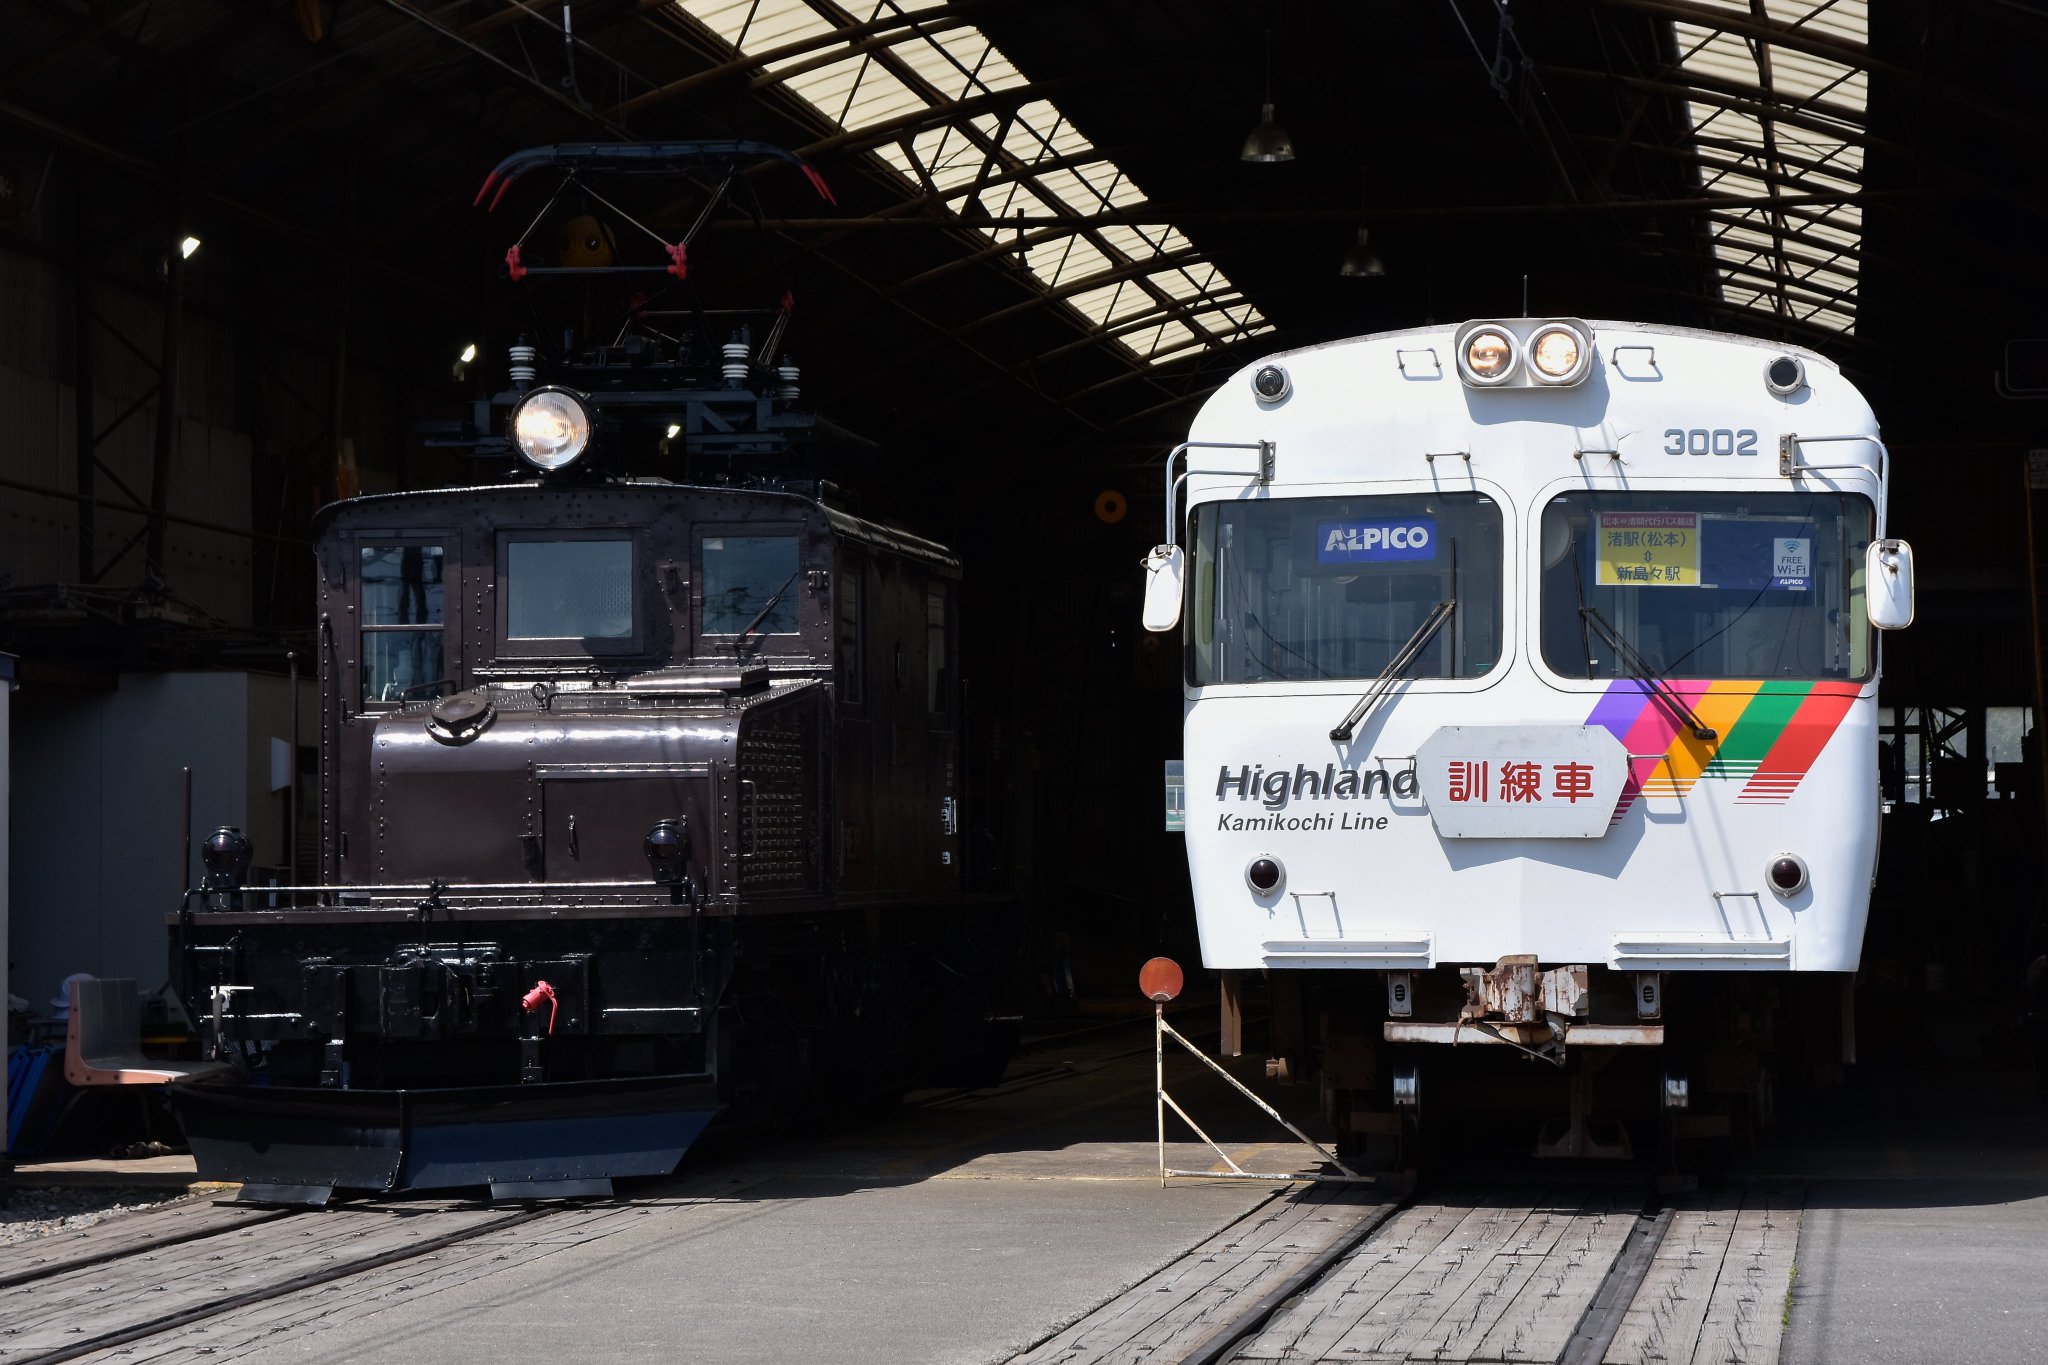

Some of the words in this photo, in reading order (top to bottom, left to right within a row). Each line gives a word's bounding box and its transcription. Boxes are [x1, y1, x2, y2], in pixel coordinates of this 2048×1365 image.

[1663, 428, 1758, 456] 3002
[1324, 525, 1430, 556] ALPICO
[1777, 564, 1806, 575] Wi-Fi
[1781, 556, 1803, 564] FREE
[1616, 565, 1681, 581] 新島々駅
[1215, 763, 1419, 810] Highland
[1447, 760, 1595, 804] 訓練車
[1217, 812, 1335, 831] Kamikochi
[1340, 811, 1389, 831] Line
